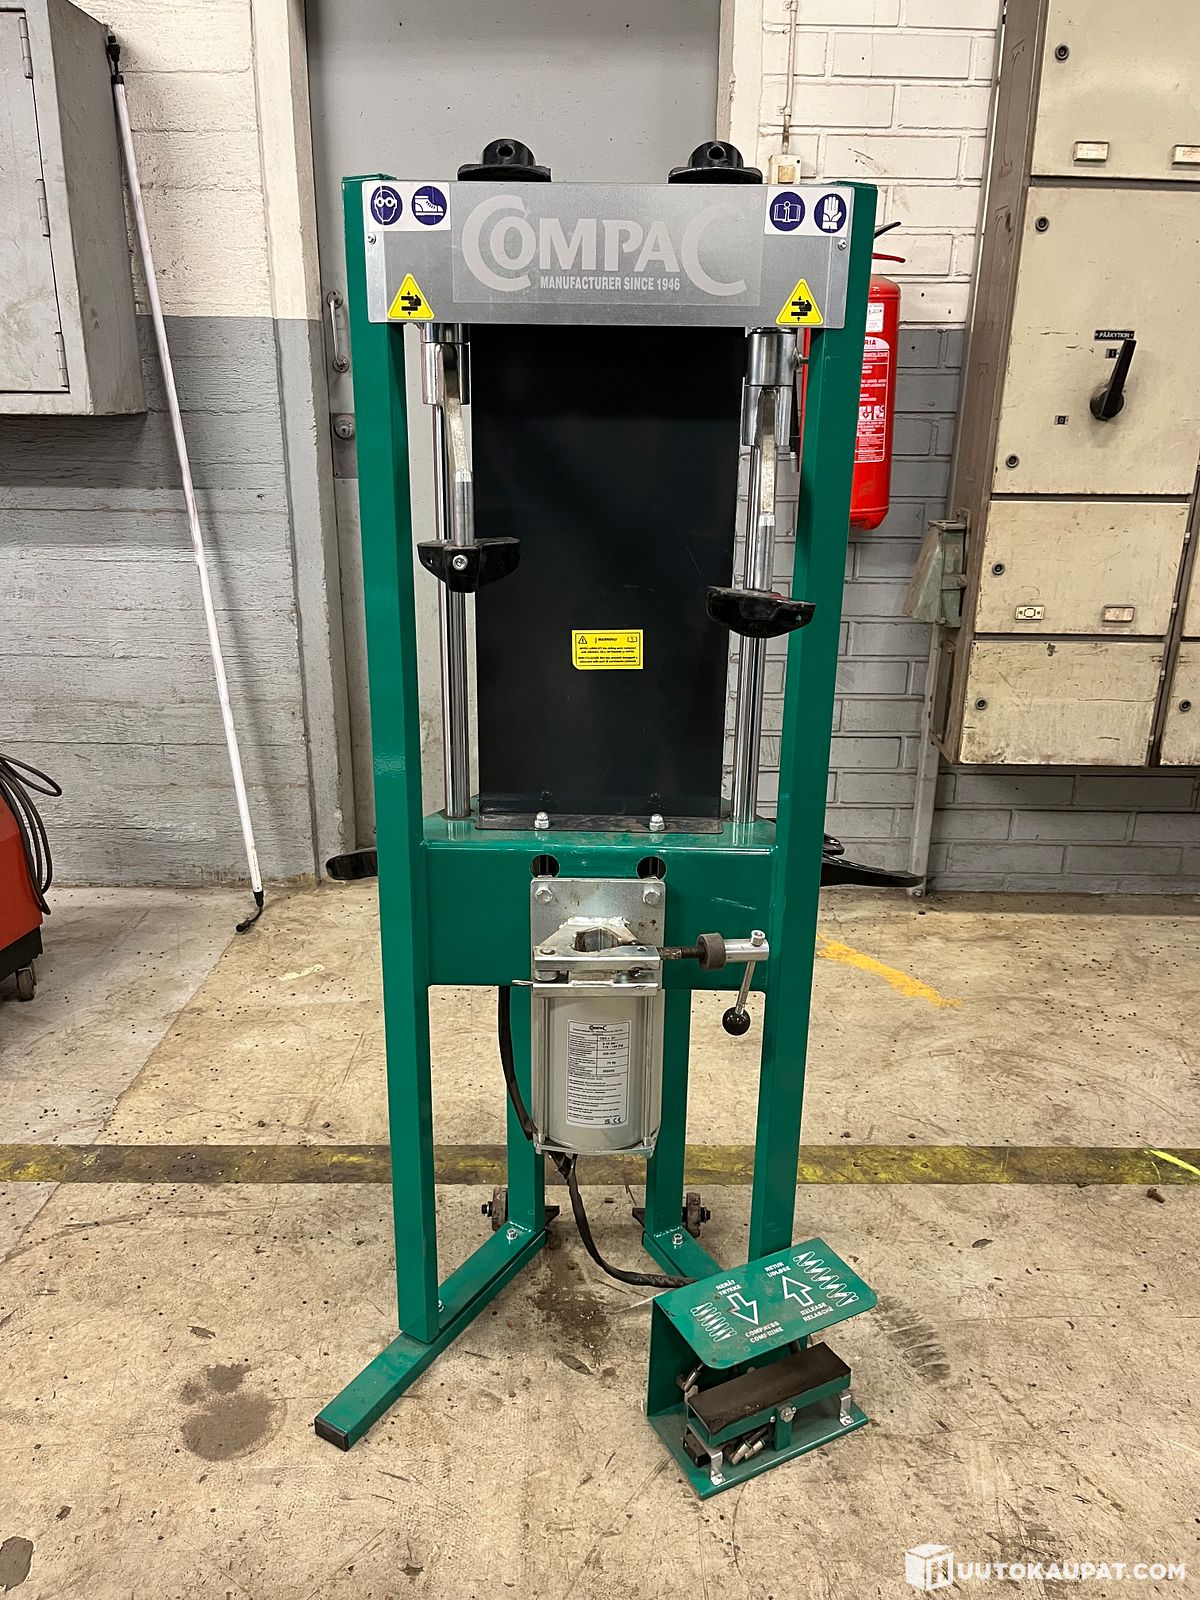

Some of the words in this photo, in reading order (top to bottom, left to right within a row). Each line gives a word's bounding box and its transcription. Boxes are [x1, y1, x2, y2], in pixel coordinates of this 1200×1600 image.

[462, 194, 747, 297] COMPAC
[540, 275, 622, 290] MANUFACTURER
[624, 276, 654, 291] SINCE
[656, 277, 681, 291] 1946
